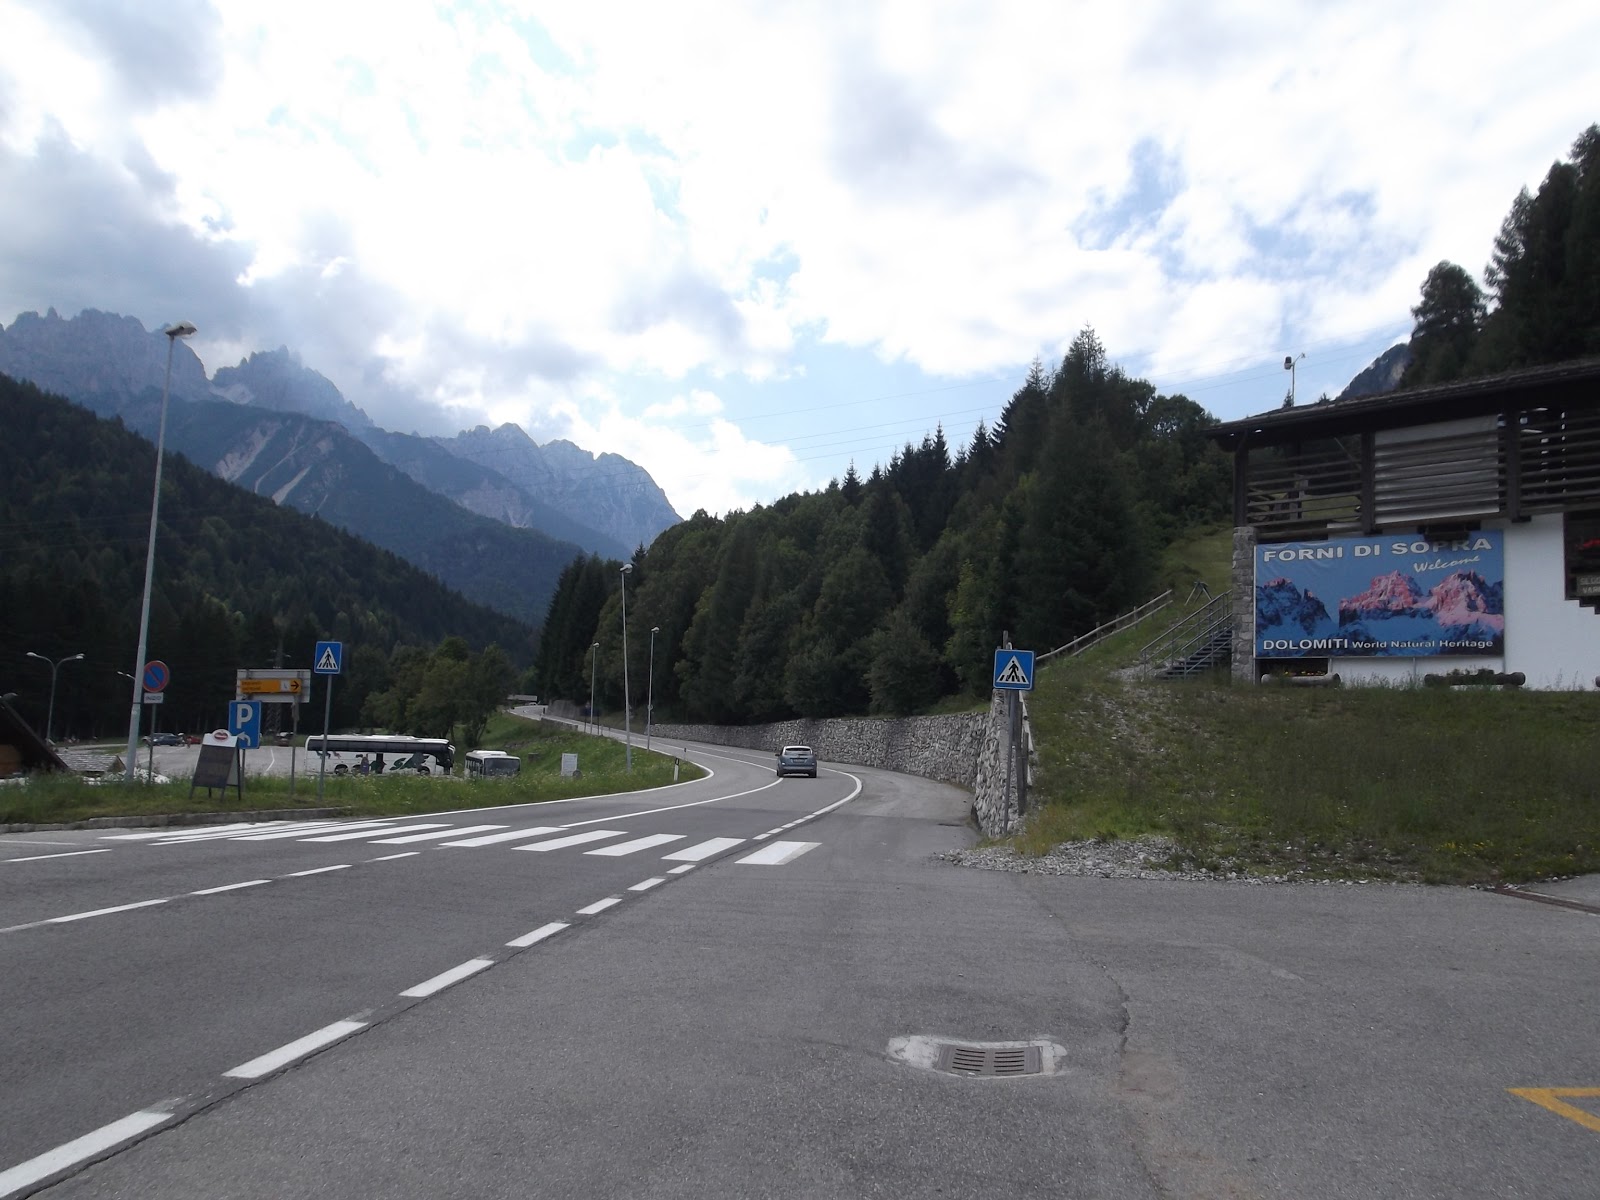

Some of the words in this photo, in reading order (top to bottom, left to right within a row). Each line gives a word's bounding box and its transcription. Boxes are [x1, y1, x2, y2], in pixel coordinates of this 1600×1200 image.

[1263, 546, 1343, 562] FORNI
[1354, 544, 1380, 557] DI
[1391, 538, 1492, 555] SOPRA
[1413, 555, 1480, 573] Welcome
[1263, 638, 1349, 650] DOLOMITI
[1352, 641, 1387, 649] World
[1391, 639, 1435, 648] Natural
[1439, 639, 1494, 649] Heritage
[236, 704, 253, 729] P
